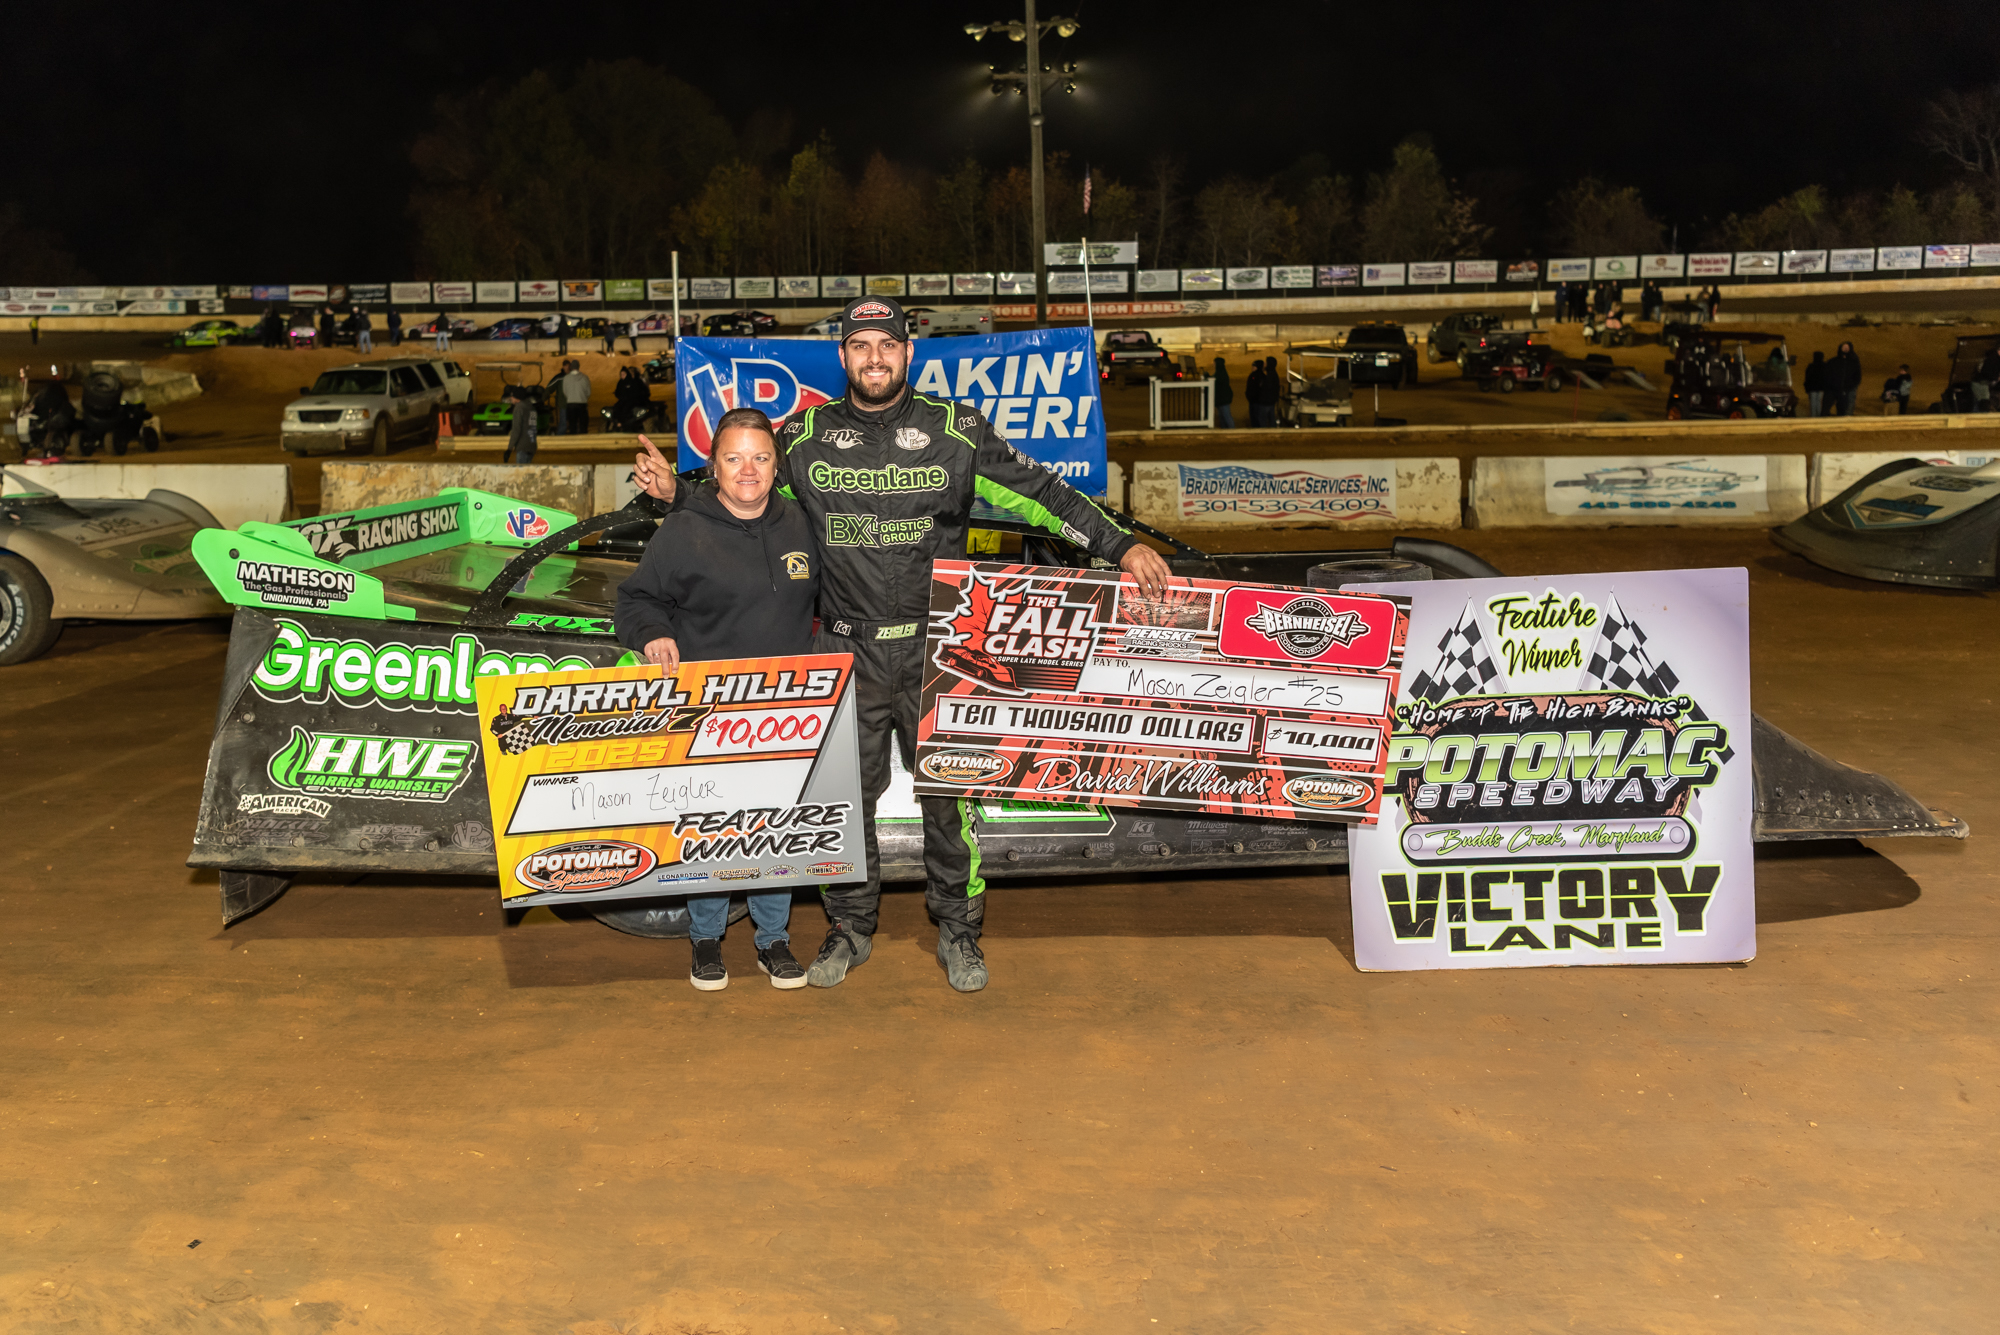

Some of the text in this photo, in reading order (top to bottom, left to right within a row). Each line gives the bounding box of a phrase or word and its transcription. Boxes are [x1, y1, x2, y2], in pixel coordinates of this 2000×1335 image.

[1056, 304, 1084, 316] THE
[1090, 304, 1124, 315] HIGH
[1132, 302, 1182, 314] BANKS
[914, 350, 1084, 398] AKIN'
[809, 461, 949, 495] Greenlane
[1185, 475, 1390, 495] BRADY MECHANICAL SERVICES, INC.
[1193, 498, 1381, 514] 301-536-4609
[358, 511, 418, 551] RACING
[420, 505, 459, 537] SHOX
[507, 508, 537, 538] VP
[826, 513, 879, 548] BX
[880, 530, 923, 545] GROUP
[238, 563, 353, 592] MATHESON
[245, 580, 348, 601] The Gas Professionals
[262, 592, 330, 608] UNIONTOWN, PA
[1026, 595, 1058, 608] THE
[1489, 591, 1597, 637] Feature
[989, 604, 1094, 639] FALL
[1126, 628, 1196, 643] PENSKE
[1262, 608, 1356, 640] BERNHEISEL
[985, 634, 1091, 660] CLASH
[1279, 632, 1331, 655] COMPONENTS
[1502, 638, 1583, 677] Winner
[1061, 660, 1084, 668] SERIES
[1092, 658, 1113, 667] PAY
[512, 669, 844, 716] DARRYL HILLS
[1127, 668, 1185, 696] Mason
[1191, 673, 1285, 705] Zeigler
[949, 703, 1245, 742] TEN THOUSAND DOLLARS
[1503, 699, 1534, 723] THE
[530, 709, 672, 745] Memorial
[705, 713, 822, 749] $10,000
[1267, 728, 1376, 750] $10,000
[300, 734, 472, 781] HWE
[550, 740, 669, 769] 2025
[929, 754, 1004, 771] POTOMAC
[1383, 726, 1719, 785] POTOMAC
[303, 774, 454, 793] HARRIS WAMSLEY
[532, 775, 579, 787] WINNER
[1033, 756, 1268, 797] David Williams
[1292, 780, 1366, 797] POTOMAC
[249, 794, 332, 818] AMERICAN
[304, 785, 448, 800] ENTERPRISE
[571, 781, 631, 820] Mason
[1413, 777, 1679, 809] SPEEDWAY
[671, 801, 853, 838] FEATURE
[681, 829, 844, 866] WINNER
[1426, 822, 1665, 855] Budds Creek, Maryland
[530, 848, 639, 874] POTOMAC
[542, 867, 628, 891] Speedway
[657, 872, 708, 880] LEONARDTOWN
[1380, 865, 1722, 940] VICTORY
[1449, 922, 1663, 953] LANE
